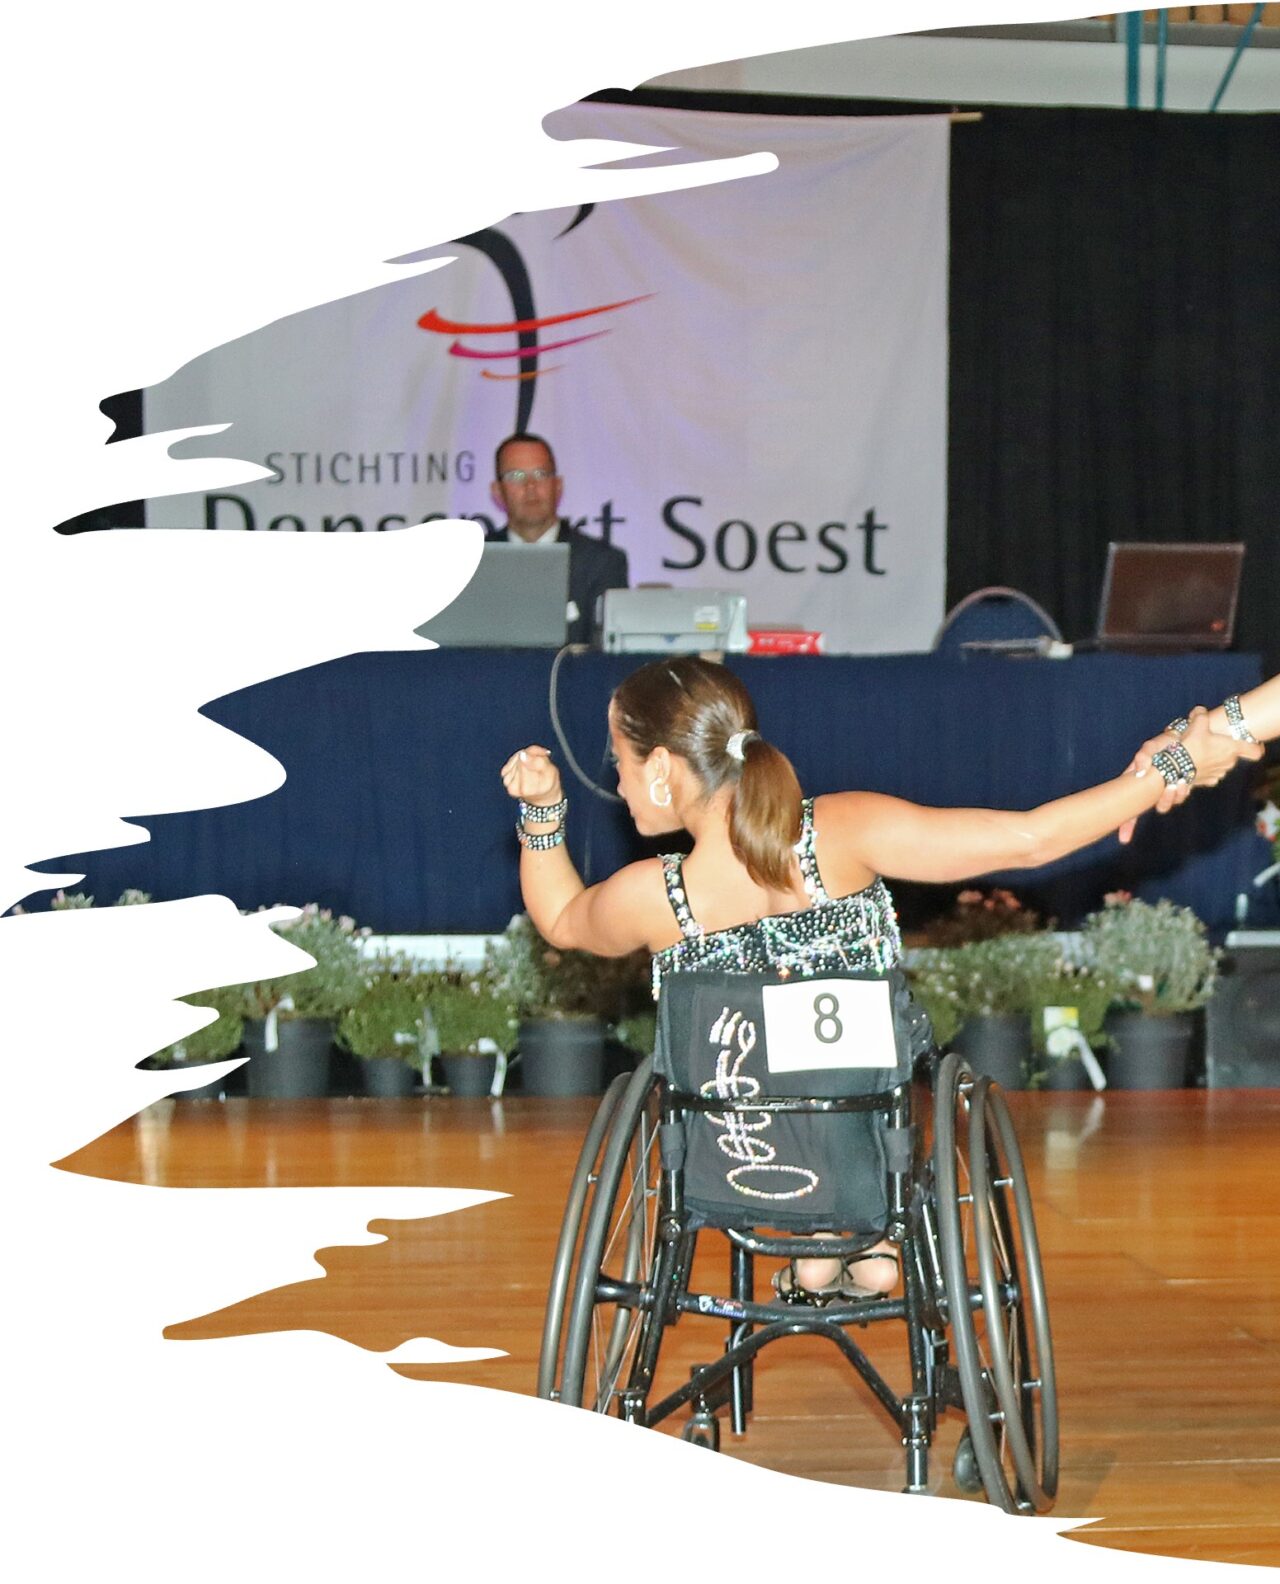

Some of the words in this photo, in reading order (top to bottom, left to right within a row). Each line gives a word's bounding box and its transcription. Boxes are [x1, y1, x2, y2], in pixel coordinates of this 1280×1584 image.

[264, 450, 477, 486] STICHTING
[661, 495, 889, 576] Soest
[813, 992, 843, 1044] 8
